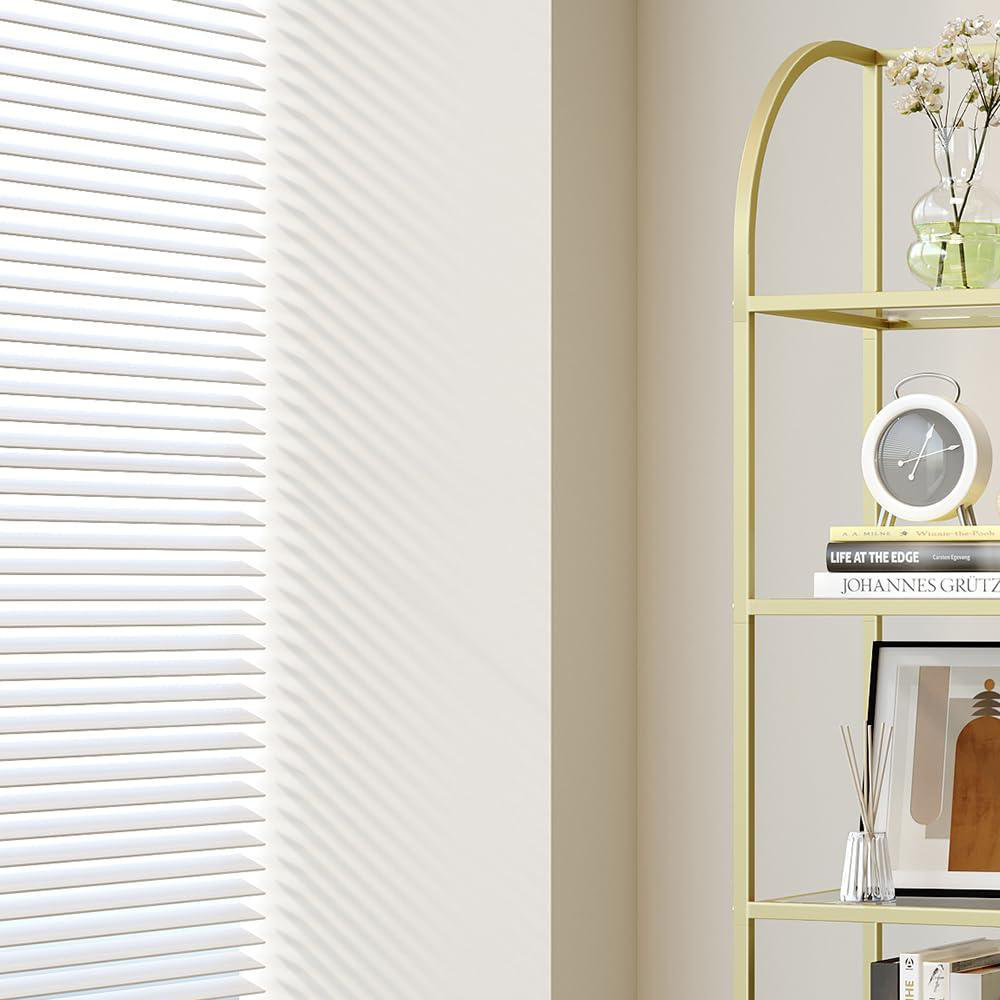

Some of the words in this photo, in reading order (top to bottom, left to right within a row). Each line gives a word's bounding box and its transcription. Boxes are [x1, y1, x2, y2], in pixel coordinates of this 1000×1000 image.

[916, 530, 996, 538] Winnie-the-Pooh
[830, 551, 853, 564] LIFE
[853, 551, 867, 564] AT
[868, 551, 890, 564] THE
[890, 551, 920, 564] EDGE
[932, 553, 949, 561] Carsten
[841, 577, 937, 595] JOHANNES
